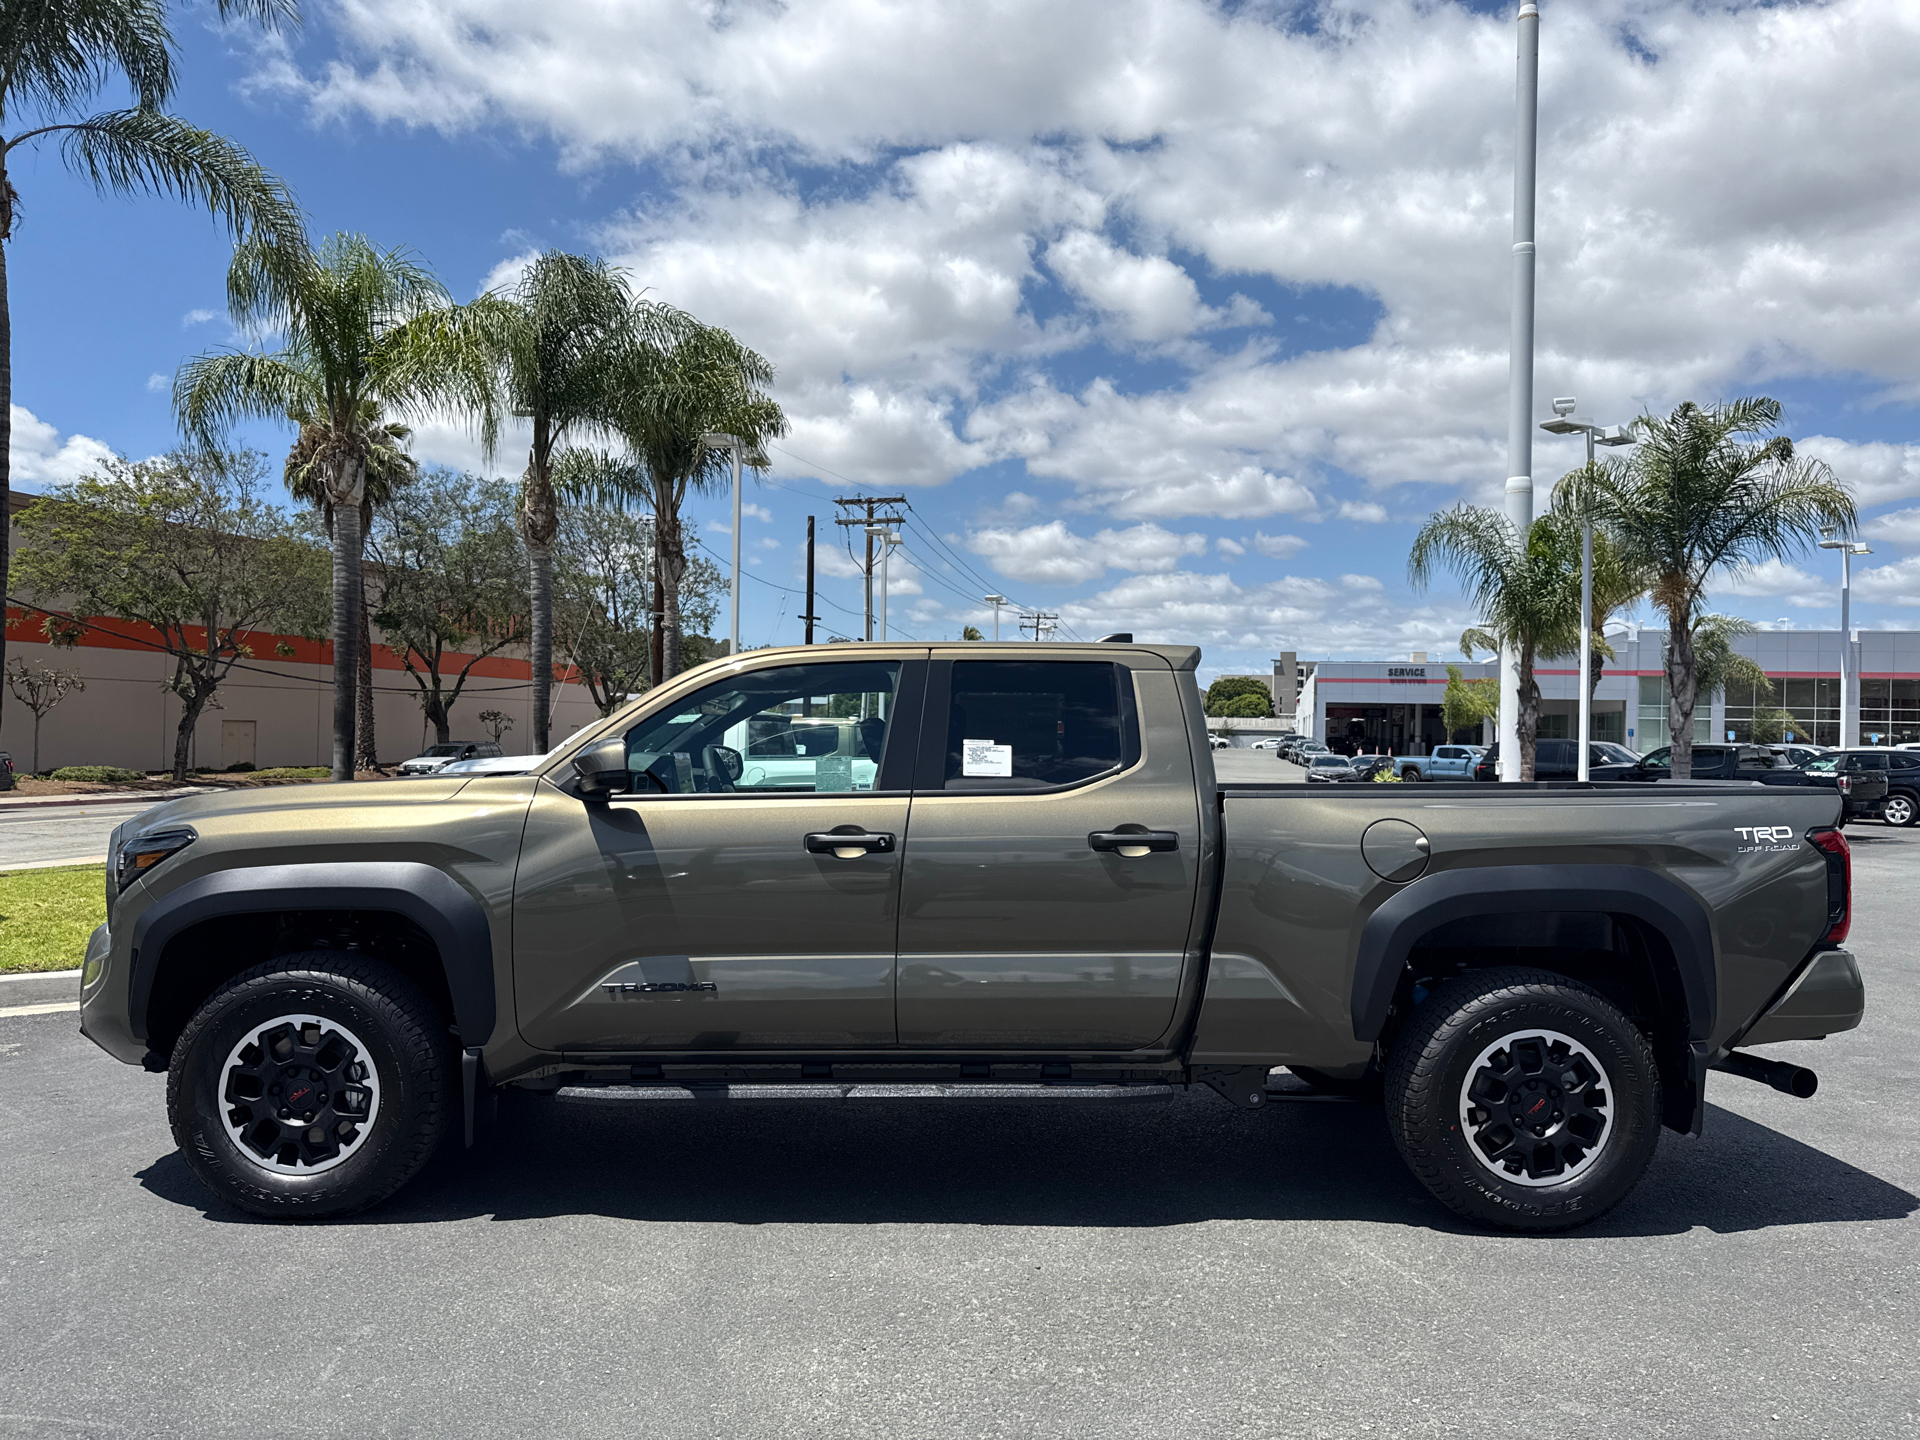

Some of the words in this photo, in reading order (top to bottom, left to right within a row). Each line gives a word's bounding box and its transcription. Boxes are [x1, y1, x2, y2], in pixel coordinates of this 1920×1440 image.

[1388, 668, 1425, 676] SERVICE
[1734, 826, 1793, 843] TRD
[1765, 844, 1800, 852] ROAD
[601, 981, 717, 992] TACOMA
